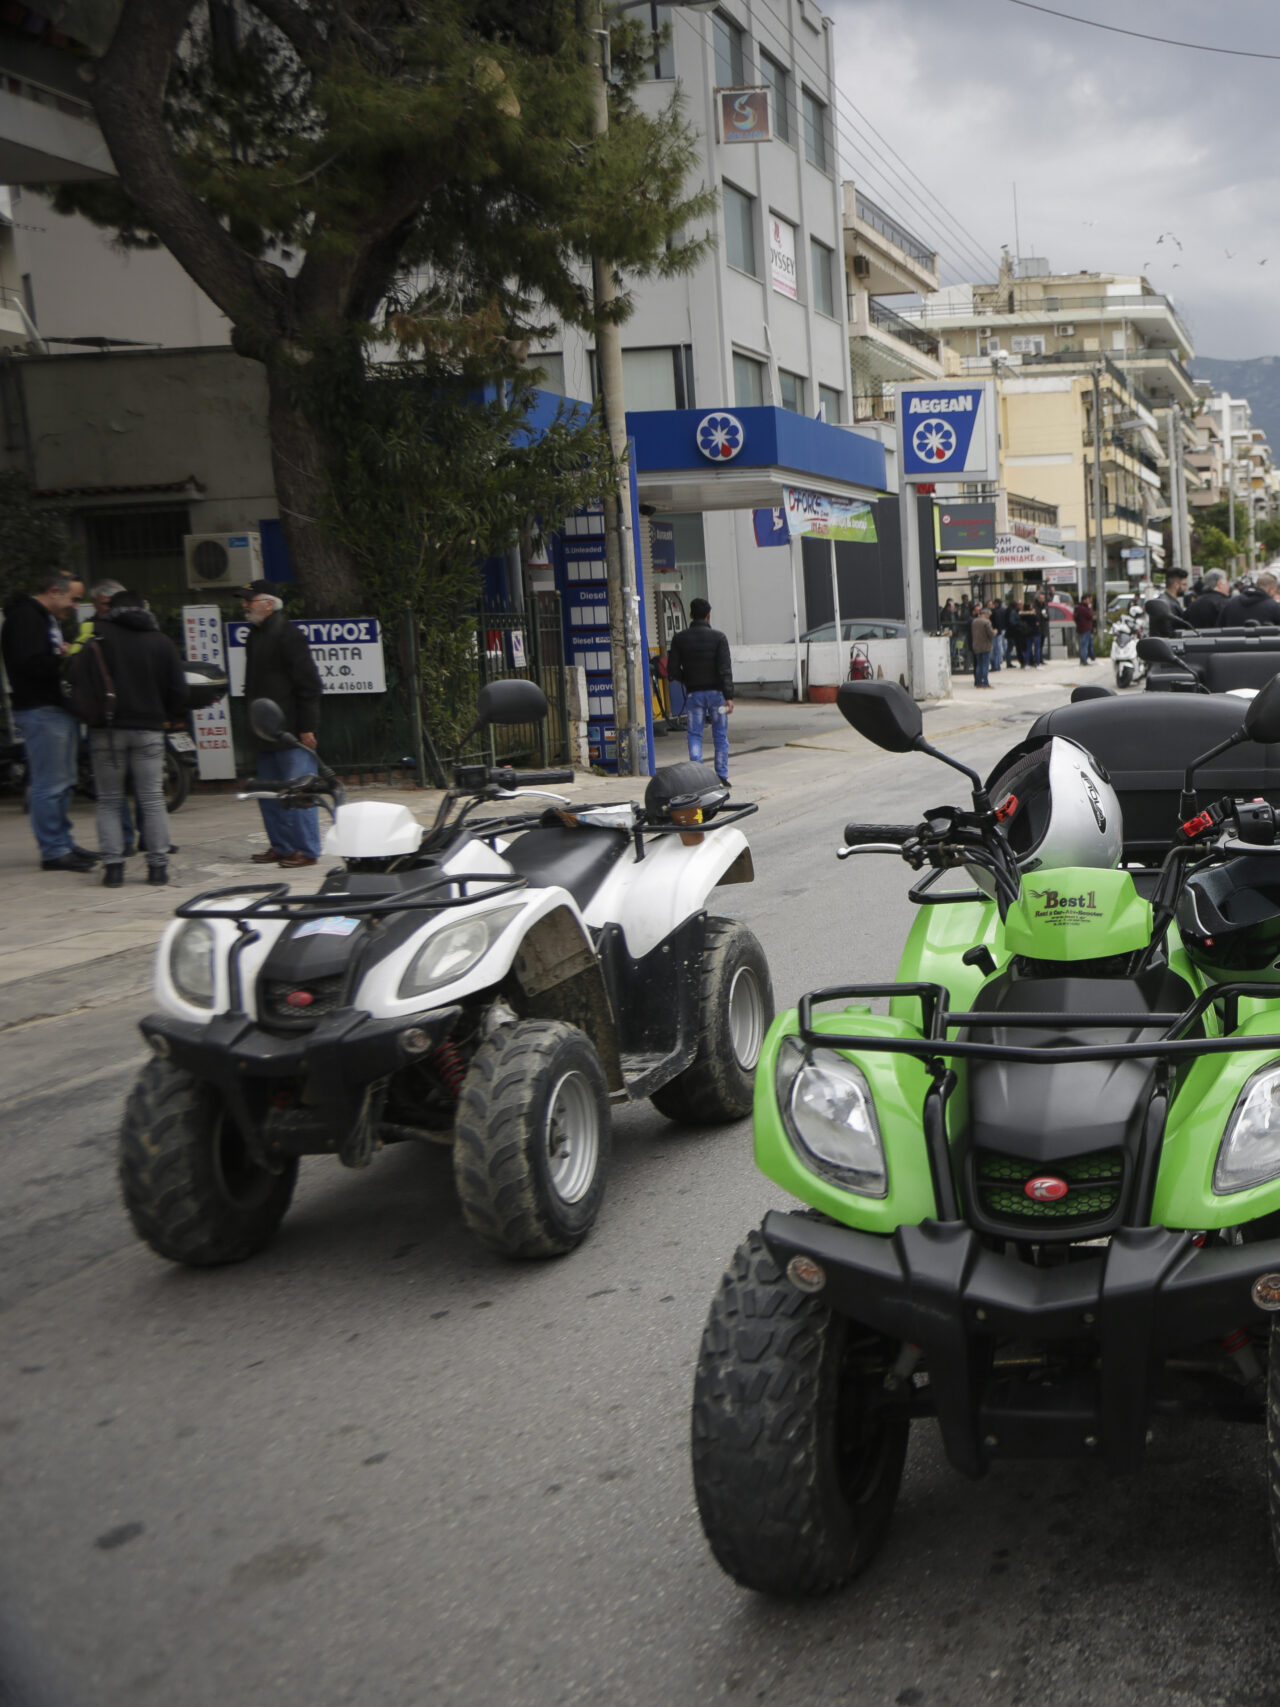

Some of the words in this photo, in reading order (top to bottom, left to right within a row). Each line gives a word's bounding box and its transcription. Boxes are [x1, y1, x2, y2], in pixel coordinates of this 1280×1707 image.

[909, 395, 973, 414] AEGEAN
[996, 554, 1034, 563] ΙΑΝΝΙΔΗΣ
[580, 592, 606, 600] Diesel
[297, 622, 370, 642] ΡΓΥΡΟΣ
[572, 636, 594, 644] Diesel
[310, 647, 362, 661] ΜΑΤΑ
[198, 727, 227, 736] ΤΑΞΙ
